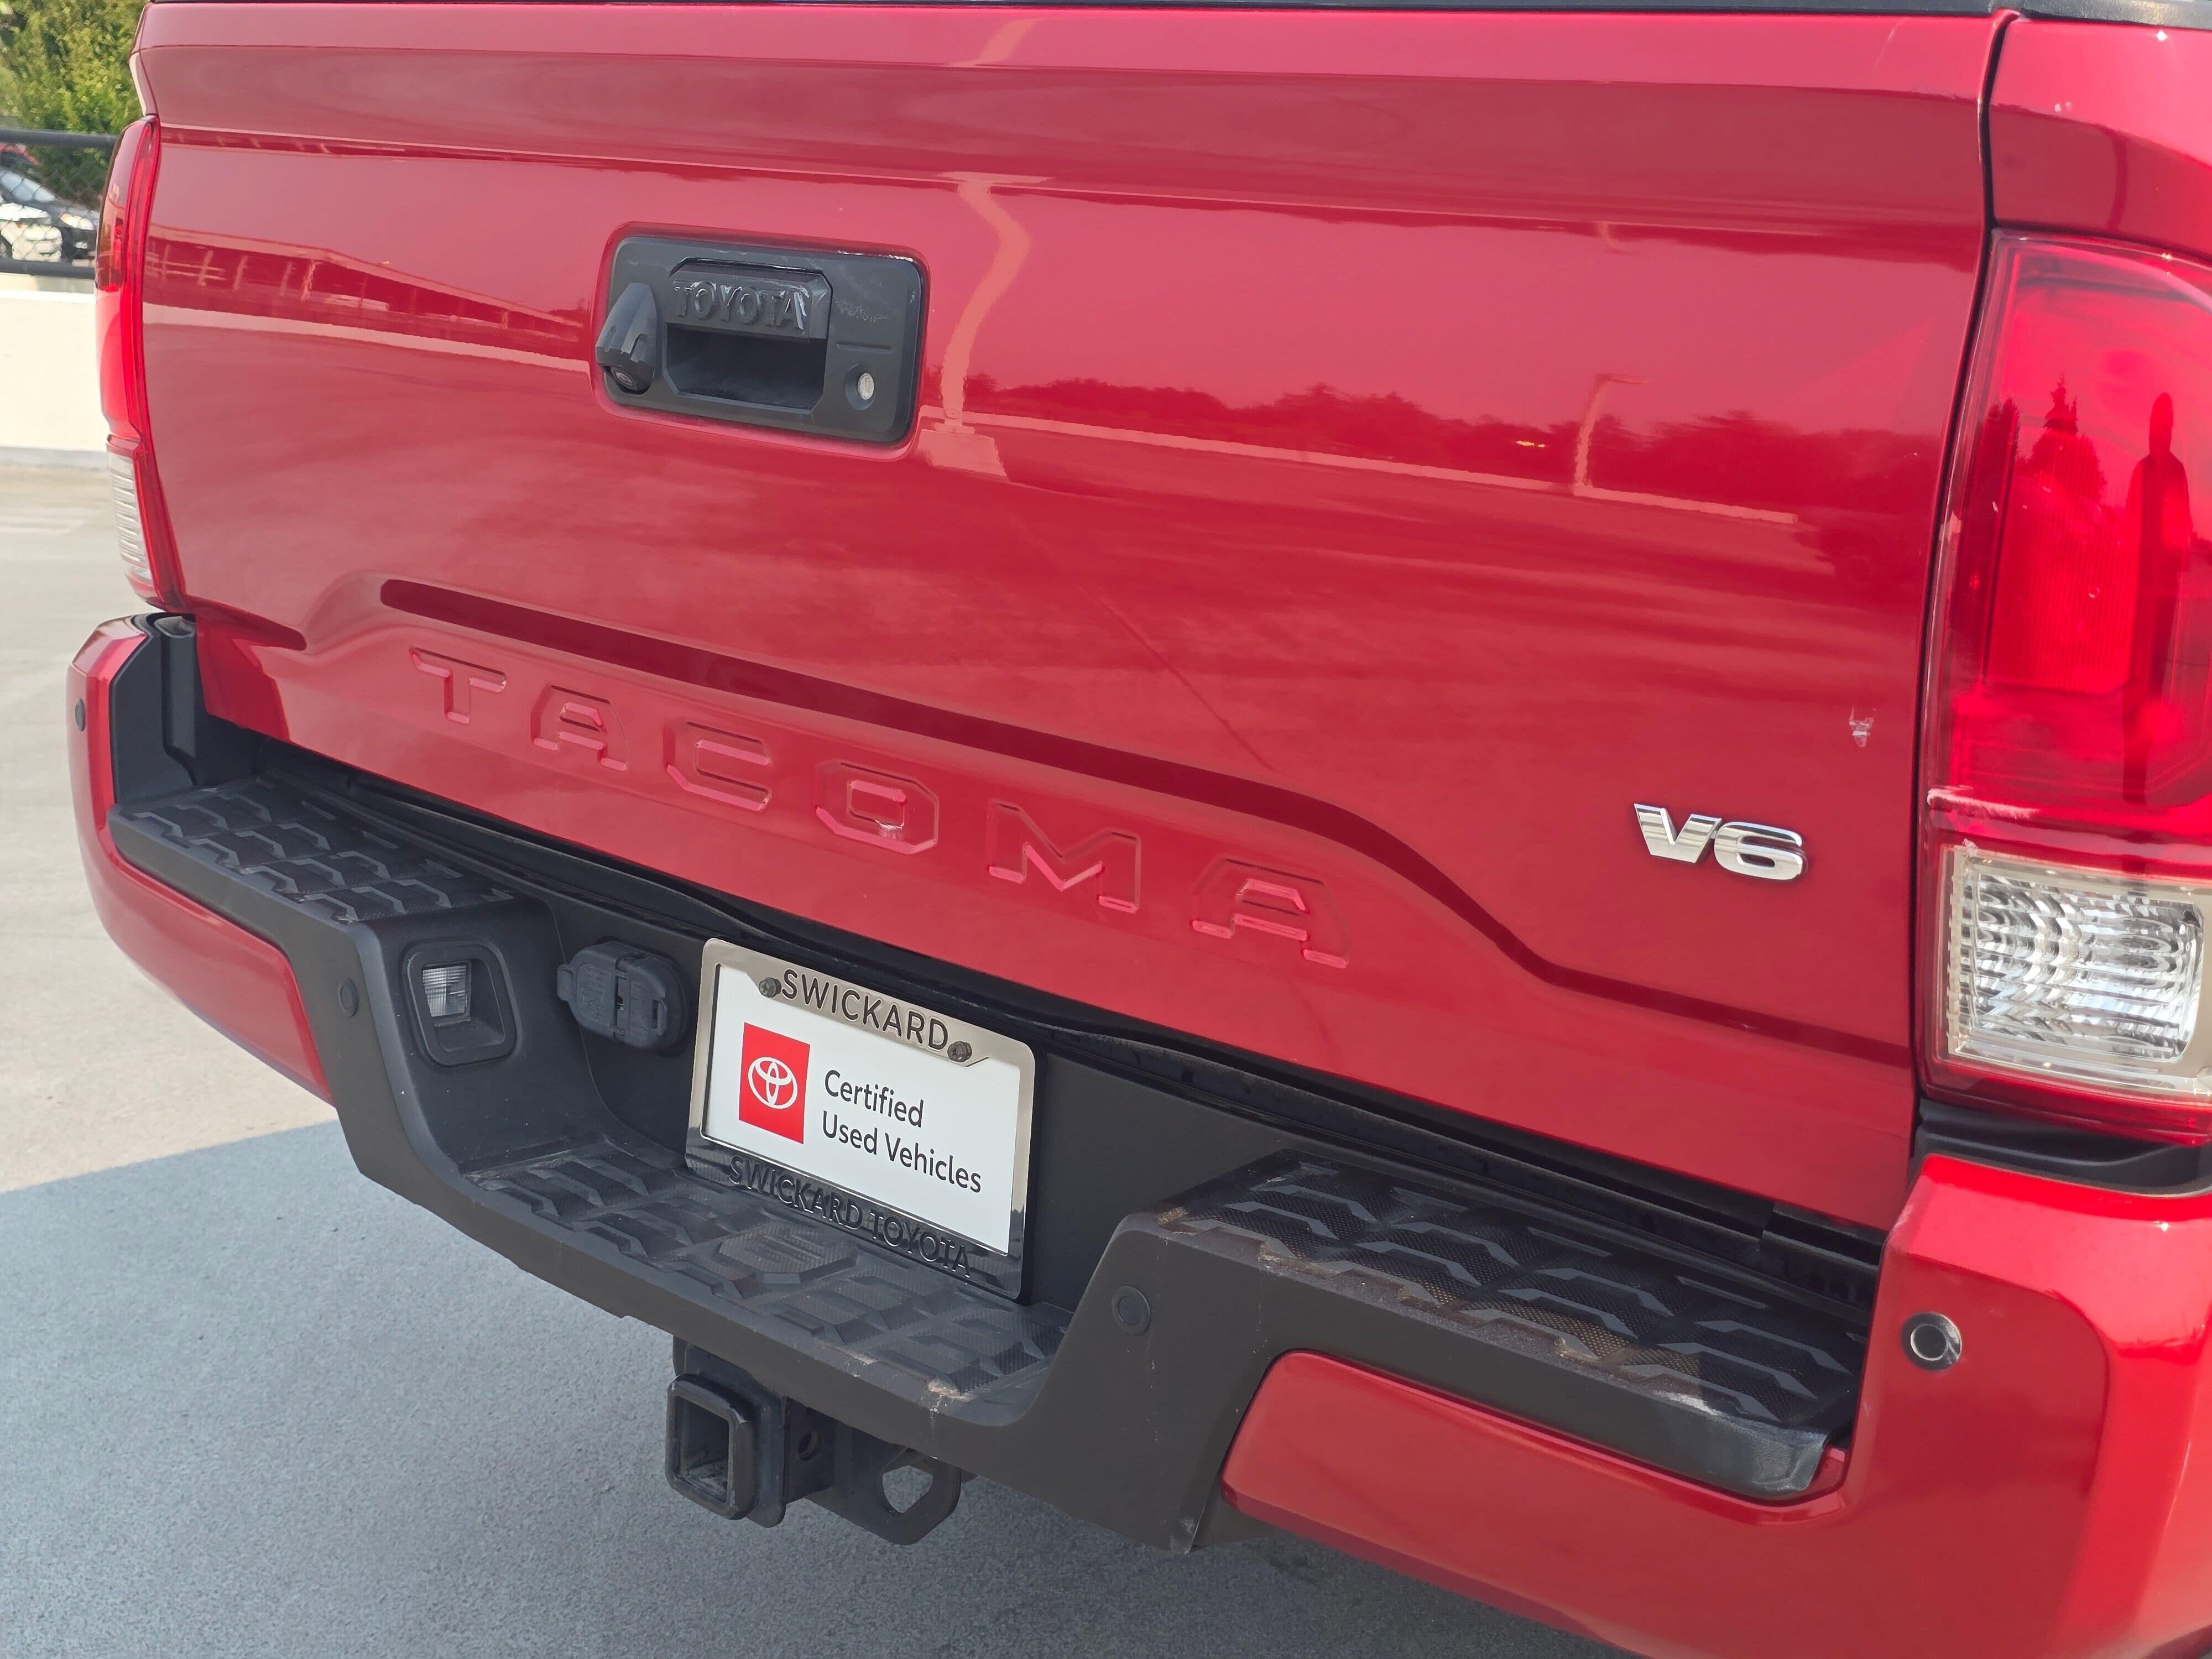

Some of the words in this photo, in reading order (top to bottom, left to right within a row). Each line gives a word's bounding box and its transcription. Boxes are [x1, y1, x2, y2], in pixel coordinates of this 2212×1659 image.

[673, 281, 808, 330] TOYOTA
[409, 646, 1350, 969] TACOMA
[1634, 803, 1807, 880] V6
[782, 969, 948, 1051] SWICKARD
[825, 1070, 924, 1128] Certified
[822, 1110, 878, 1156] Used
[886, 1132, 982, 1193] Vehicles
[729, 1156, 863, 1229] SWICKARD
[869, 1211, 971, 1278] TOYOTA
